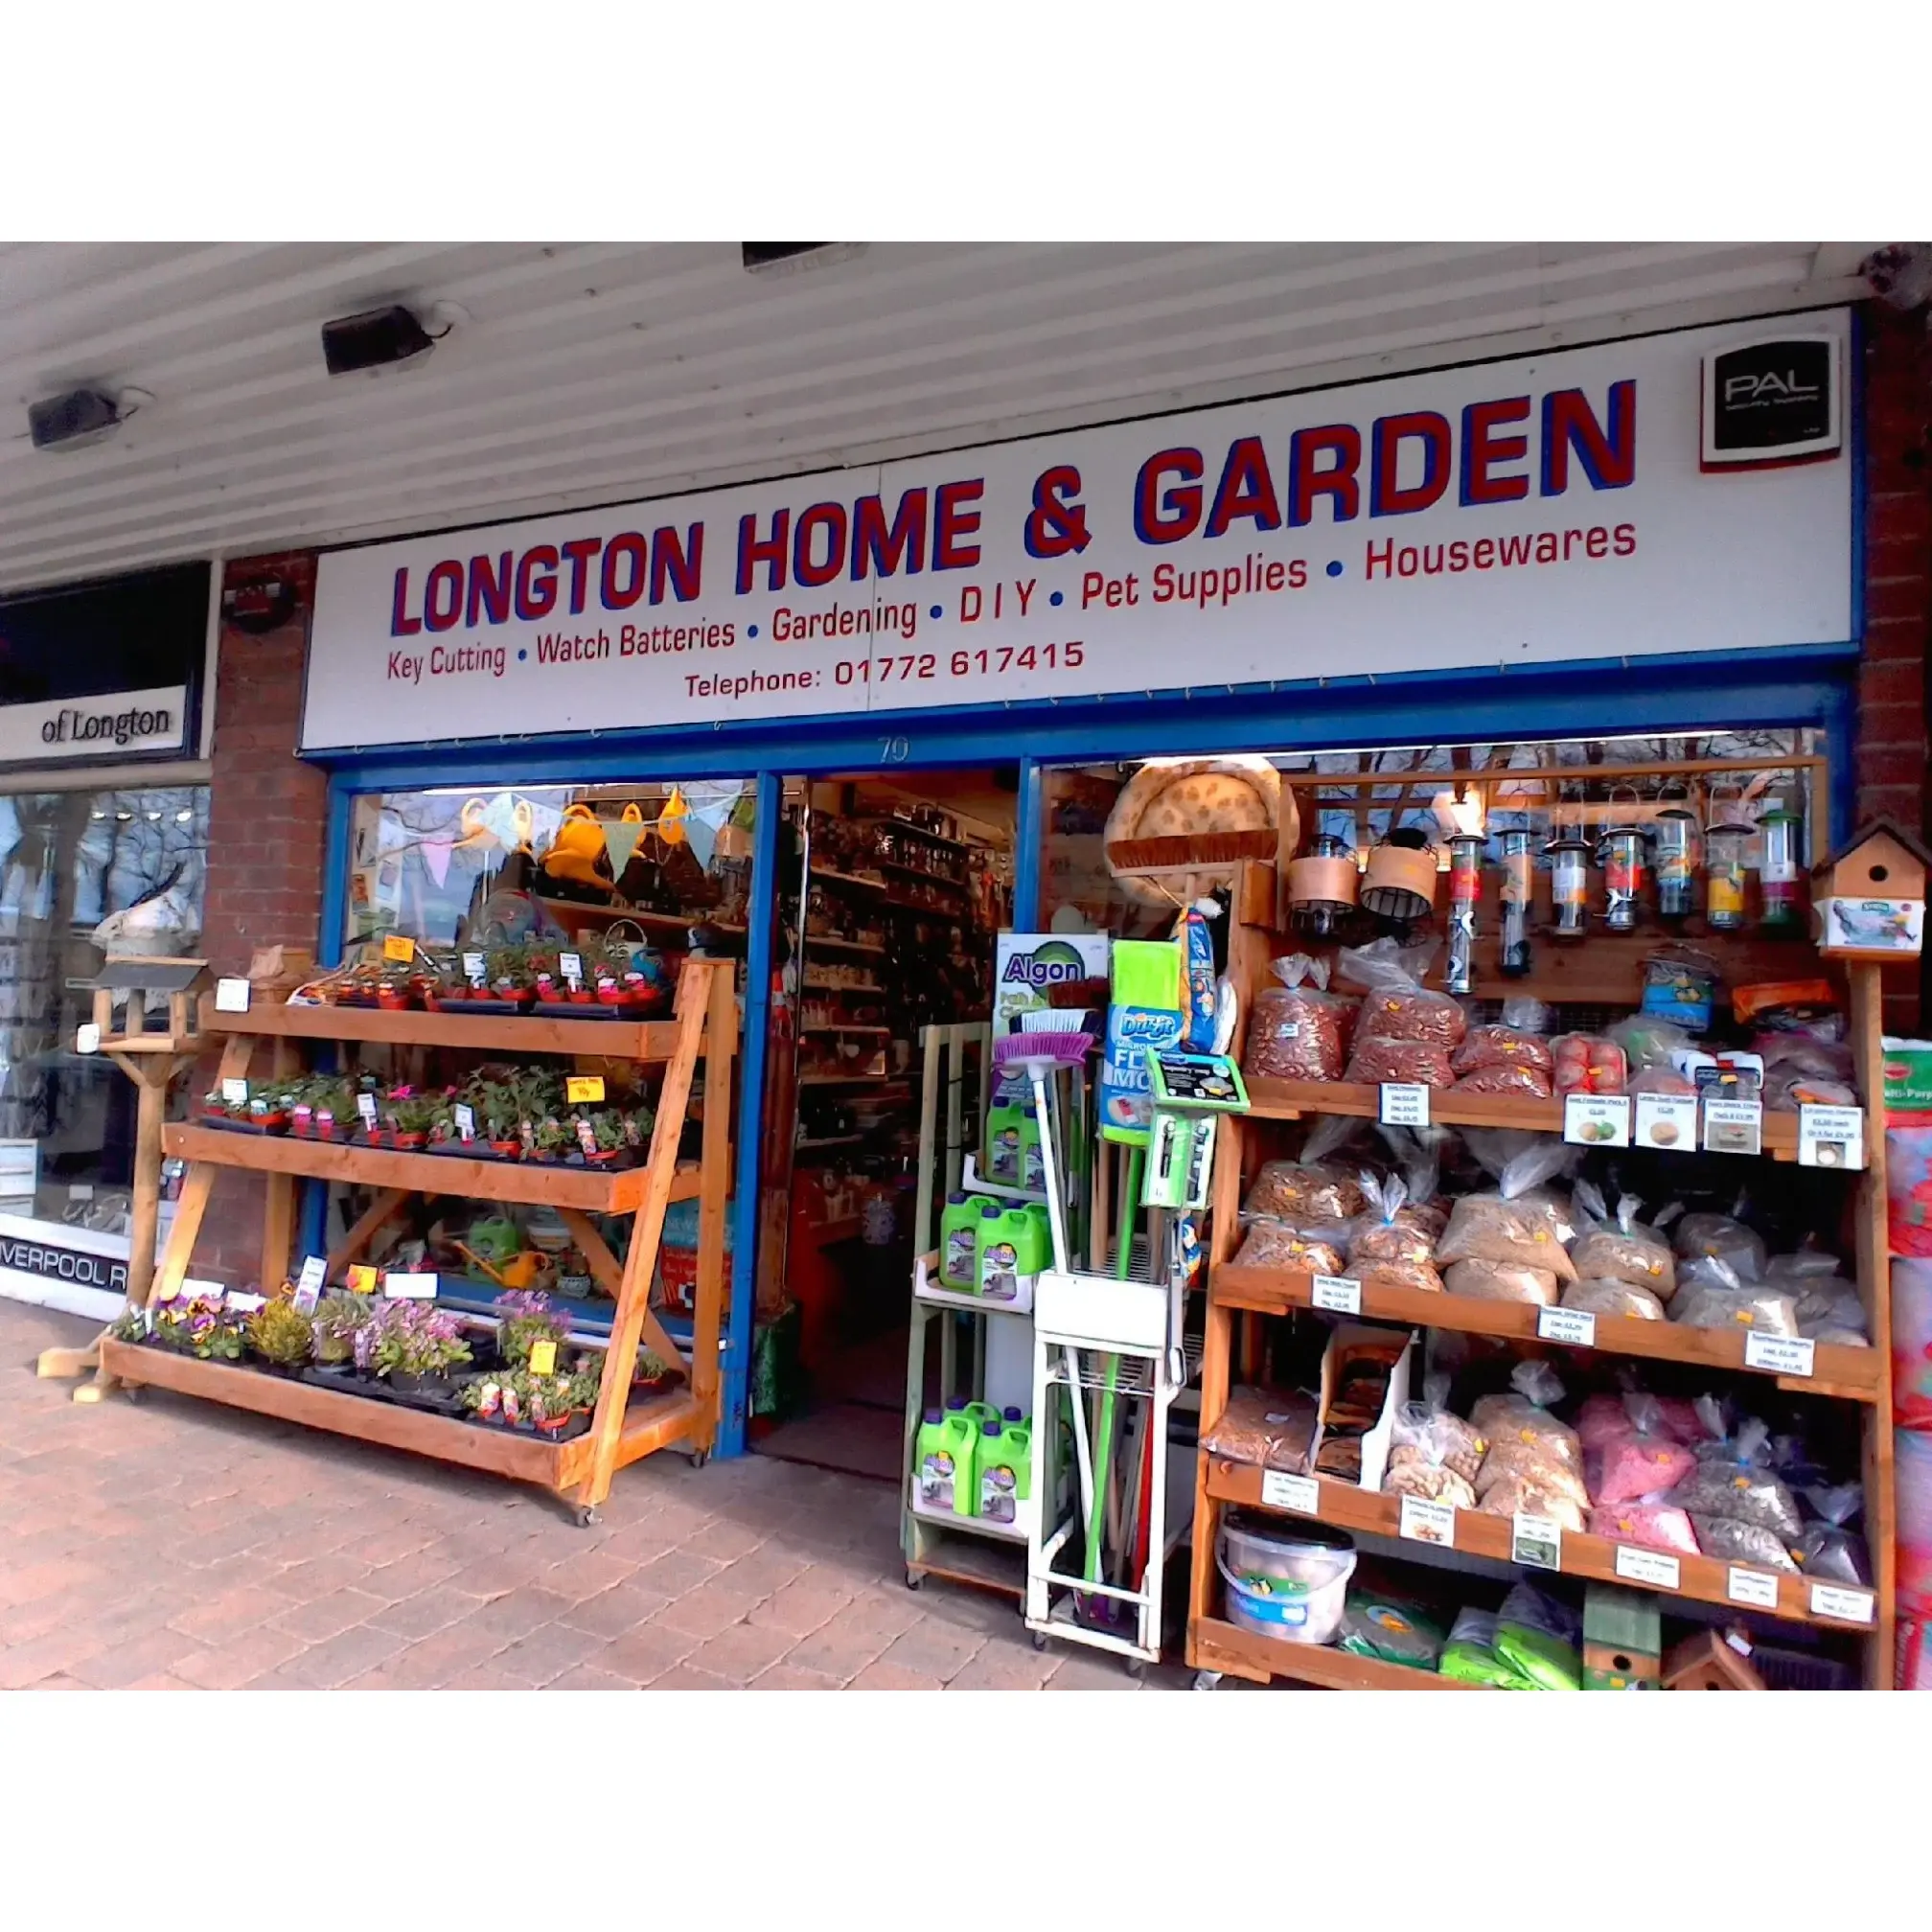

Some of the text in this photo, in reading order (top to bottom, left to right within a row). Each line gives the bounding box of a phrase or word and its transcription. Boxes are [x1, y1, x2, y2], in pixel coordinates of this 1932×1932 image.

[1724, 368, 1820, 402] PAL
[390, 379, 1637, 637] LONGTON HOME & GARDEN
[387, 649, 424, 684] Key
[430, 641, 506, 678] Cutting
[537, 629, 610, 665] Watch
[620, 617, 736, 658] Batteries
[772, 599, 917, 645] Gardening
[1082, 572, 1139, 610] Pet
[1153, 552, 1308, 610] Supplies
[1366, 522, 1637, 580] Housewares
[685, 641, 1084, 700] Telephone: 01772 617415
[41, 706, 170, 745] of Longton
[877, 735, 909, 764] 70
[1005, 955, 1081, 986] Algon
